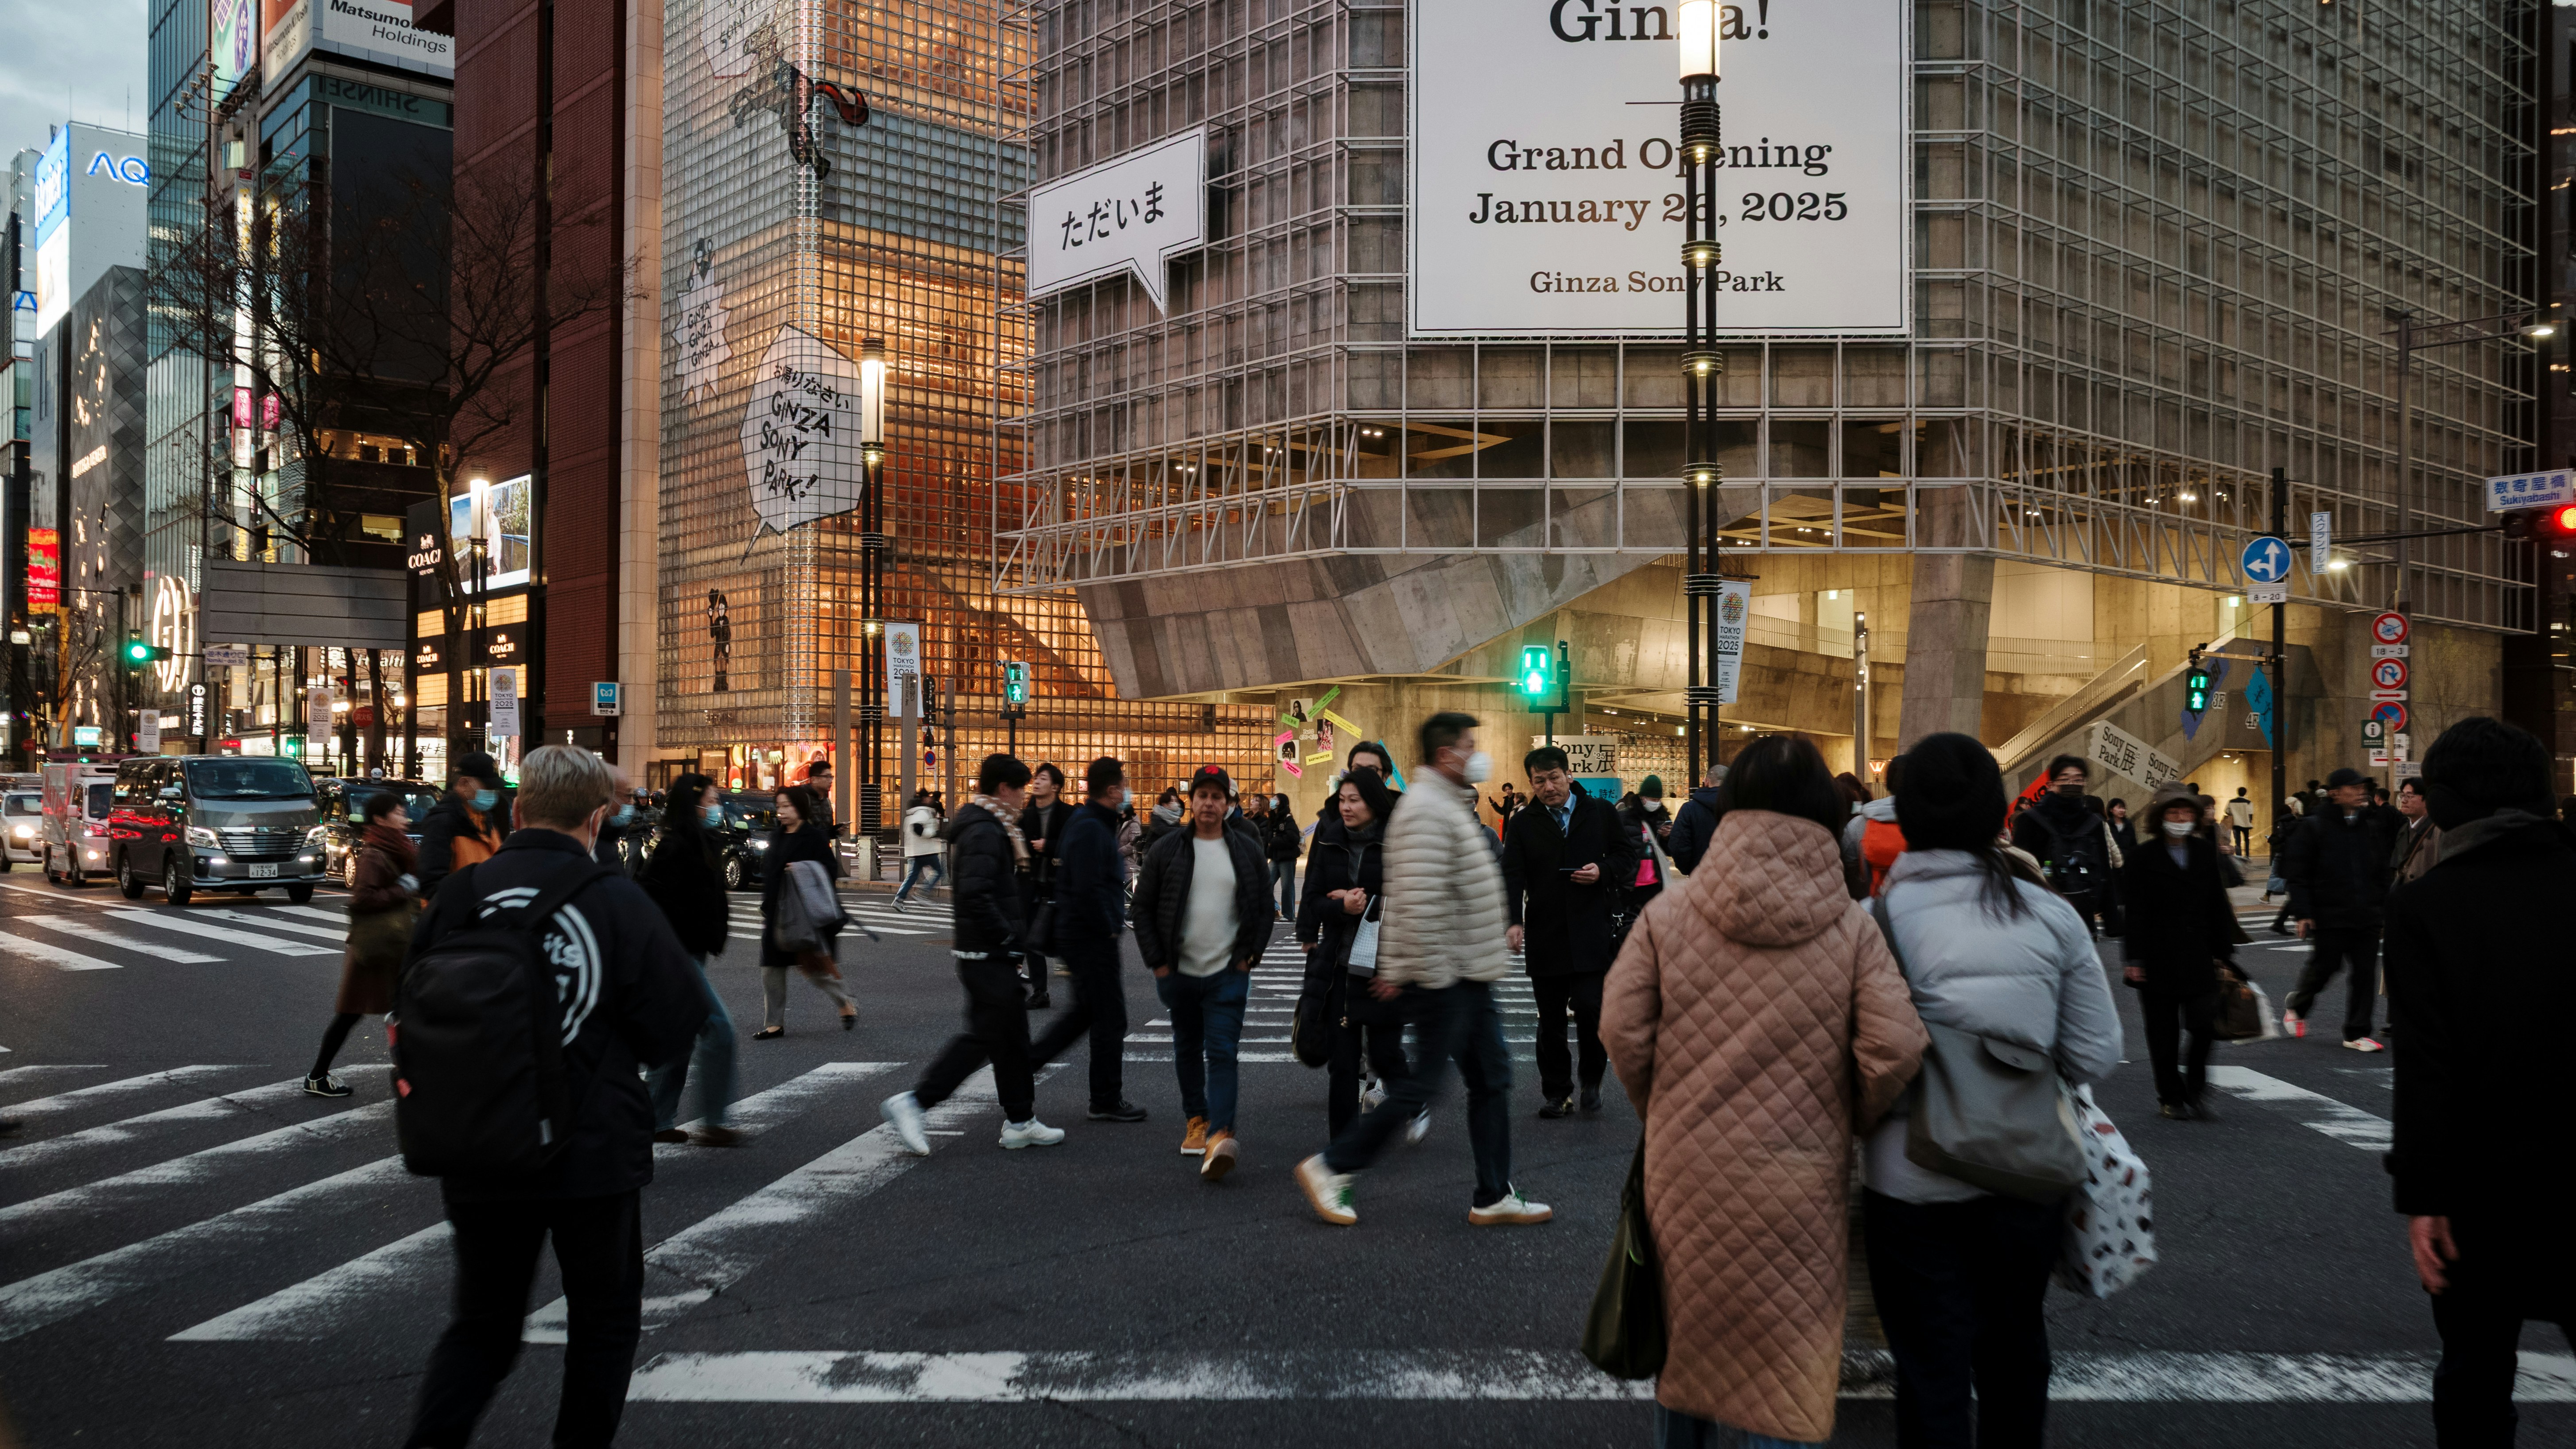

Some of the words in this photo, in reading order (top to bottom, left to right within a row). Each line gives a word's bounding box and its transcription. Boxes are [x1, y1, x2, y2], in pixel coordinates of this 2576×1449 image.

[330, 0, 422, 32] Matsumo
[1550, 0, 1769, 43] Gina!
[372, 25, 447, 53] Holdings
[1487, 139, 1627, 171] Grand
[1061, 181, 1164, 251] ただいま
[1469, 193, 1651, 231] January
[1741, 192, 1848, 221] 2025
[1530, 271, 1619, 293] Ginza
[1715, 271, 1785, 292] Park
[687, 300, 710, 329] GINZA
[689, 318, 712, 348] GINZA
[773, 362, 849, 410] お帰りなさい
[772, 390, 830, 438] GINZA
[760, 420, 809, 461] SONY
[2494, 474, 2565, 495] 数寄屋橋
[2499, 490, 2560, 505] Sukiyabashi
[2315, 515, 2326, 572] スクランブル式
[1720, 626, 1741, 635] TOKYO
[416, 653, 438, 664] COACH
[489, 643, 515, 655] COACH
[1718, 640, 1739, 651] 2025
[357, 653, 404, 667] Halth
[2212, 693, 2226, 708] 3F
[2246, 713, 2259, 728] 4F
[1552, 740, 1595, 758] ony
[2103, 726, 2125, 752] Sony
[1308, 754, 1330, 762] BABYMONSTER
[1571, 759, 1594, 773] rk
[1595, 744, 1616, 773] 展
[2098, 744, 2121, 768] Park
[2119, 742, 2138, 775] 展
[2148, 752, 2170, 778] Sony
